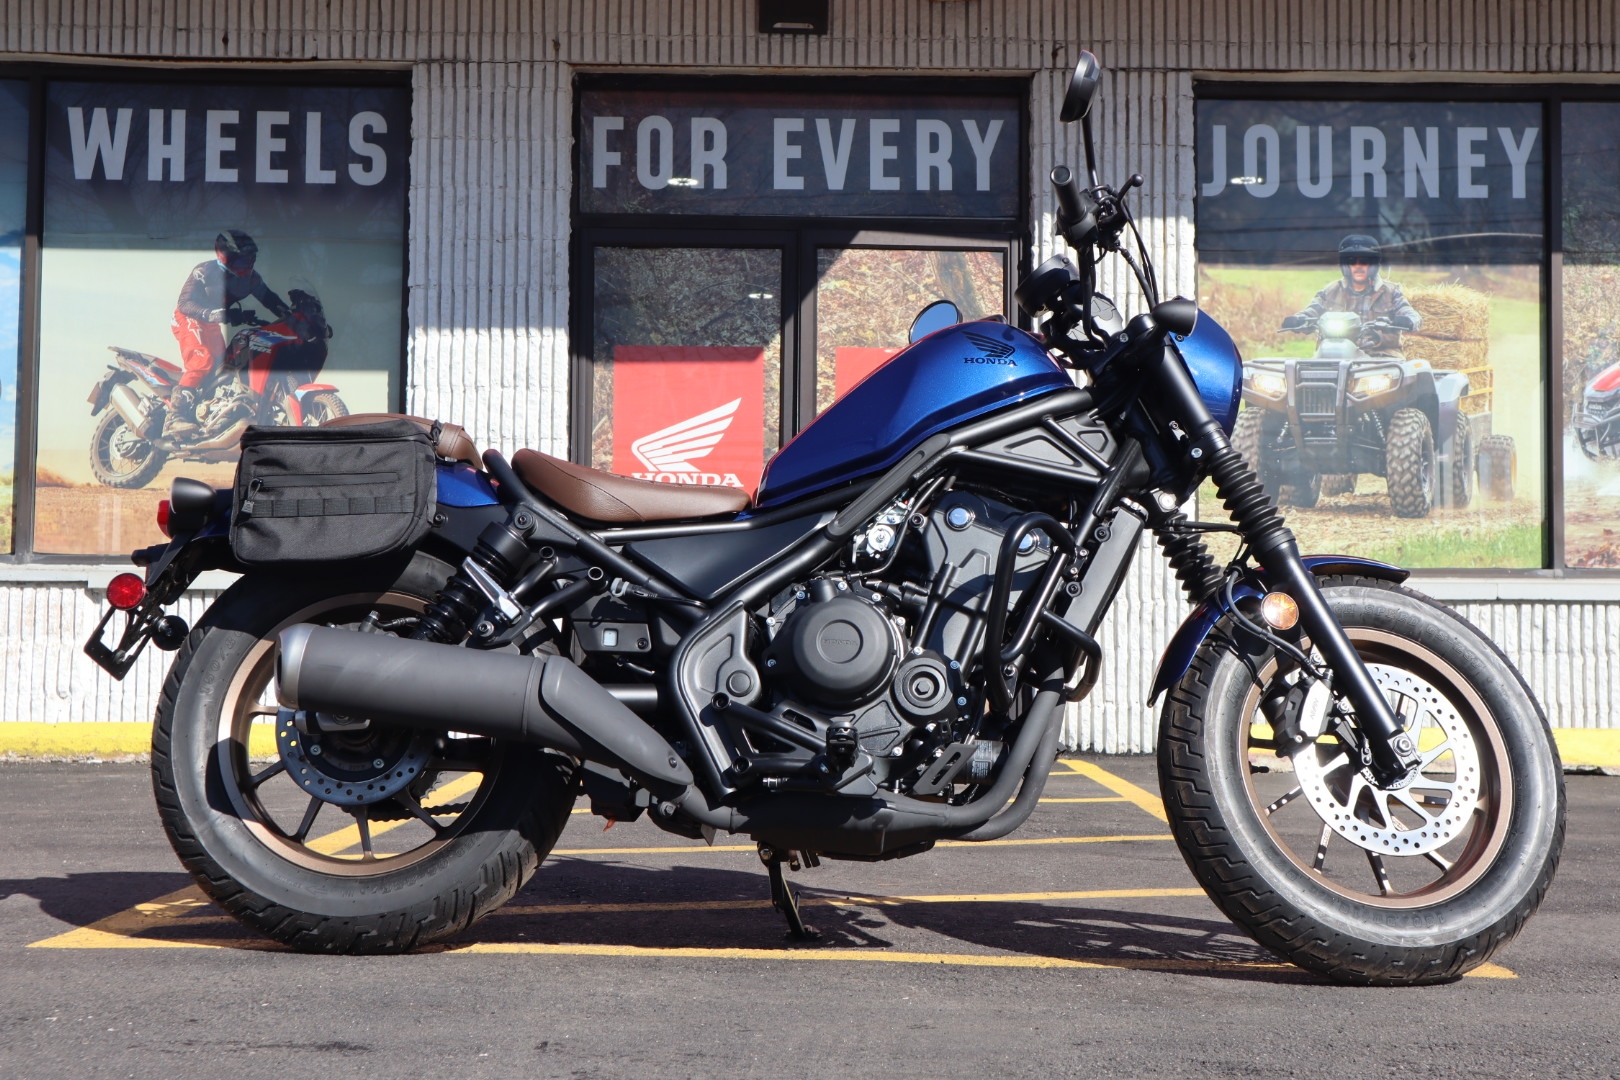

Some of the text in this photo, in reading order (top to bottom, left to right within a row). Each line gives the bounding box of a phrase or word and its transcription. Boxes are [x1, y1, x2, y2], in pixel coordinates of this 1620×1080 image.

[67, 107, 388, 186] WHEELS
[592, 115, 1004, 192] FOR EVERY
[1202, 123, 1540, 199] JOURNEY
[963, 357, 1018, 367] HONDA
